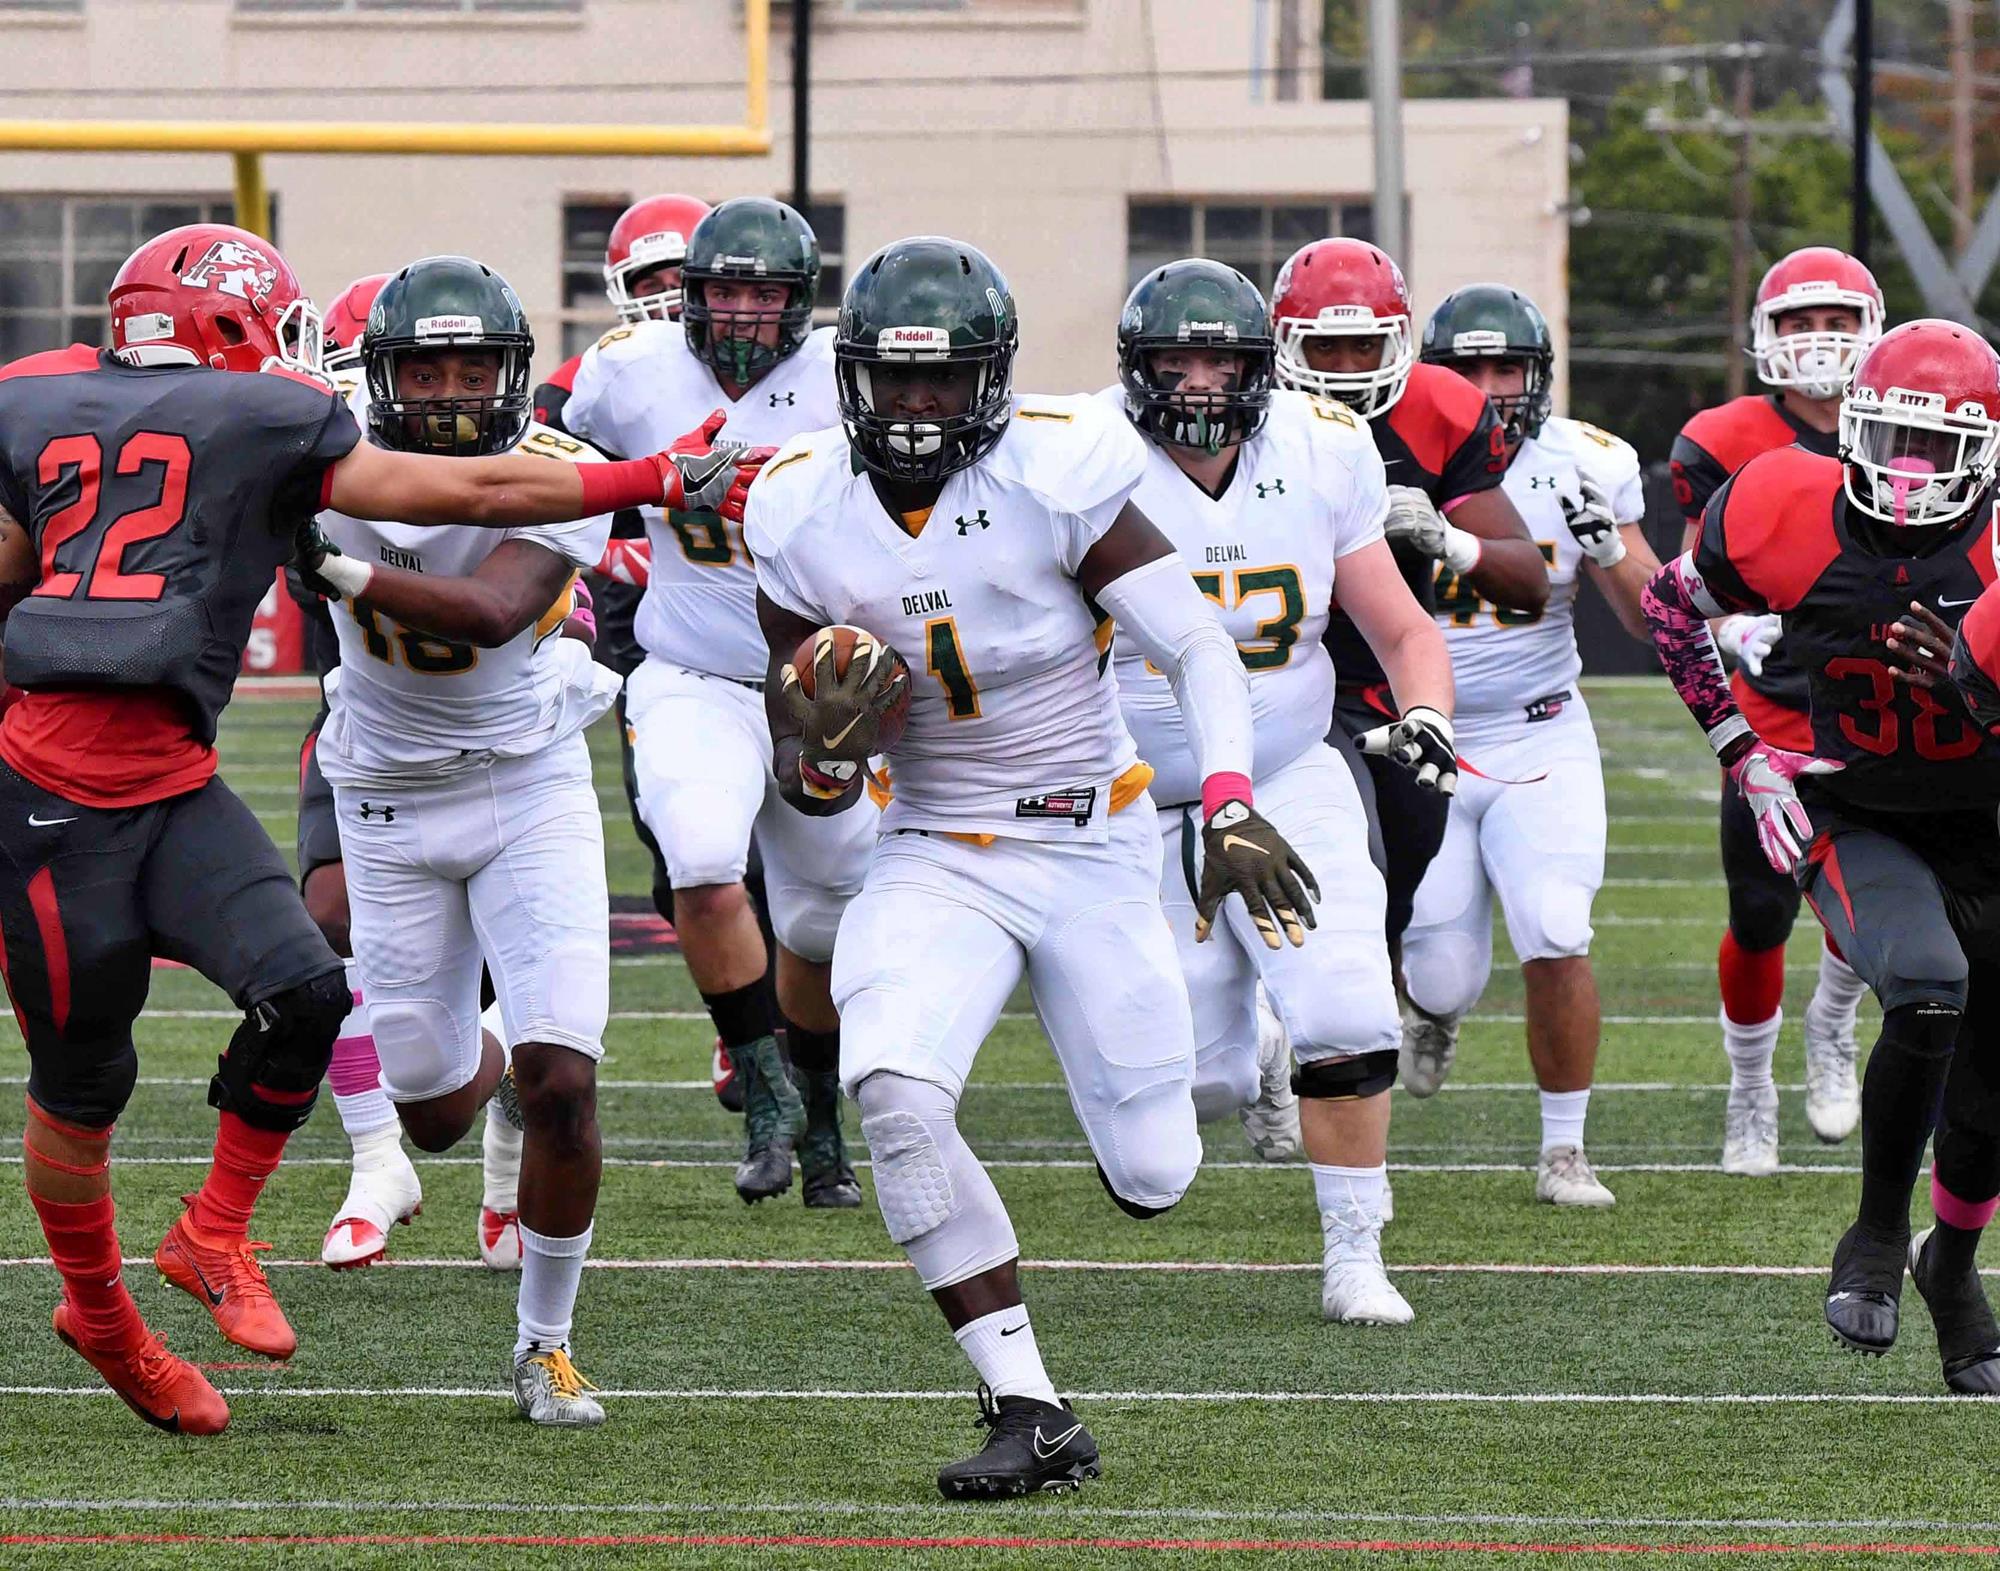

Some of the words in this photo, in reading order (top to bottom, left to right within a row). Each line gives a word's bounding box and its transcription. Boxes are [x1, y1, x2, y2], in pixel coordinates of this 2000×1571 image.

[430, 319, 467, 329] Riddell
[895, 330, 933, 341] Riddell
[1900, 394, 1930, 407] RYFP
[31, 429, 194, 602] 22
[380, 546, 423, 573] DELVAL
[1206, 544, 1247, 563] DELVAL
[902, 589, 952, 615] DELVAL
[925, 616, 982, 720] 1
